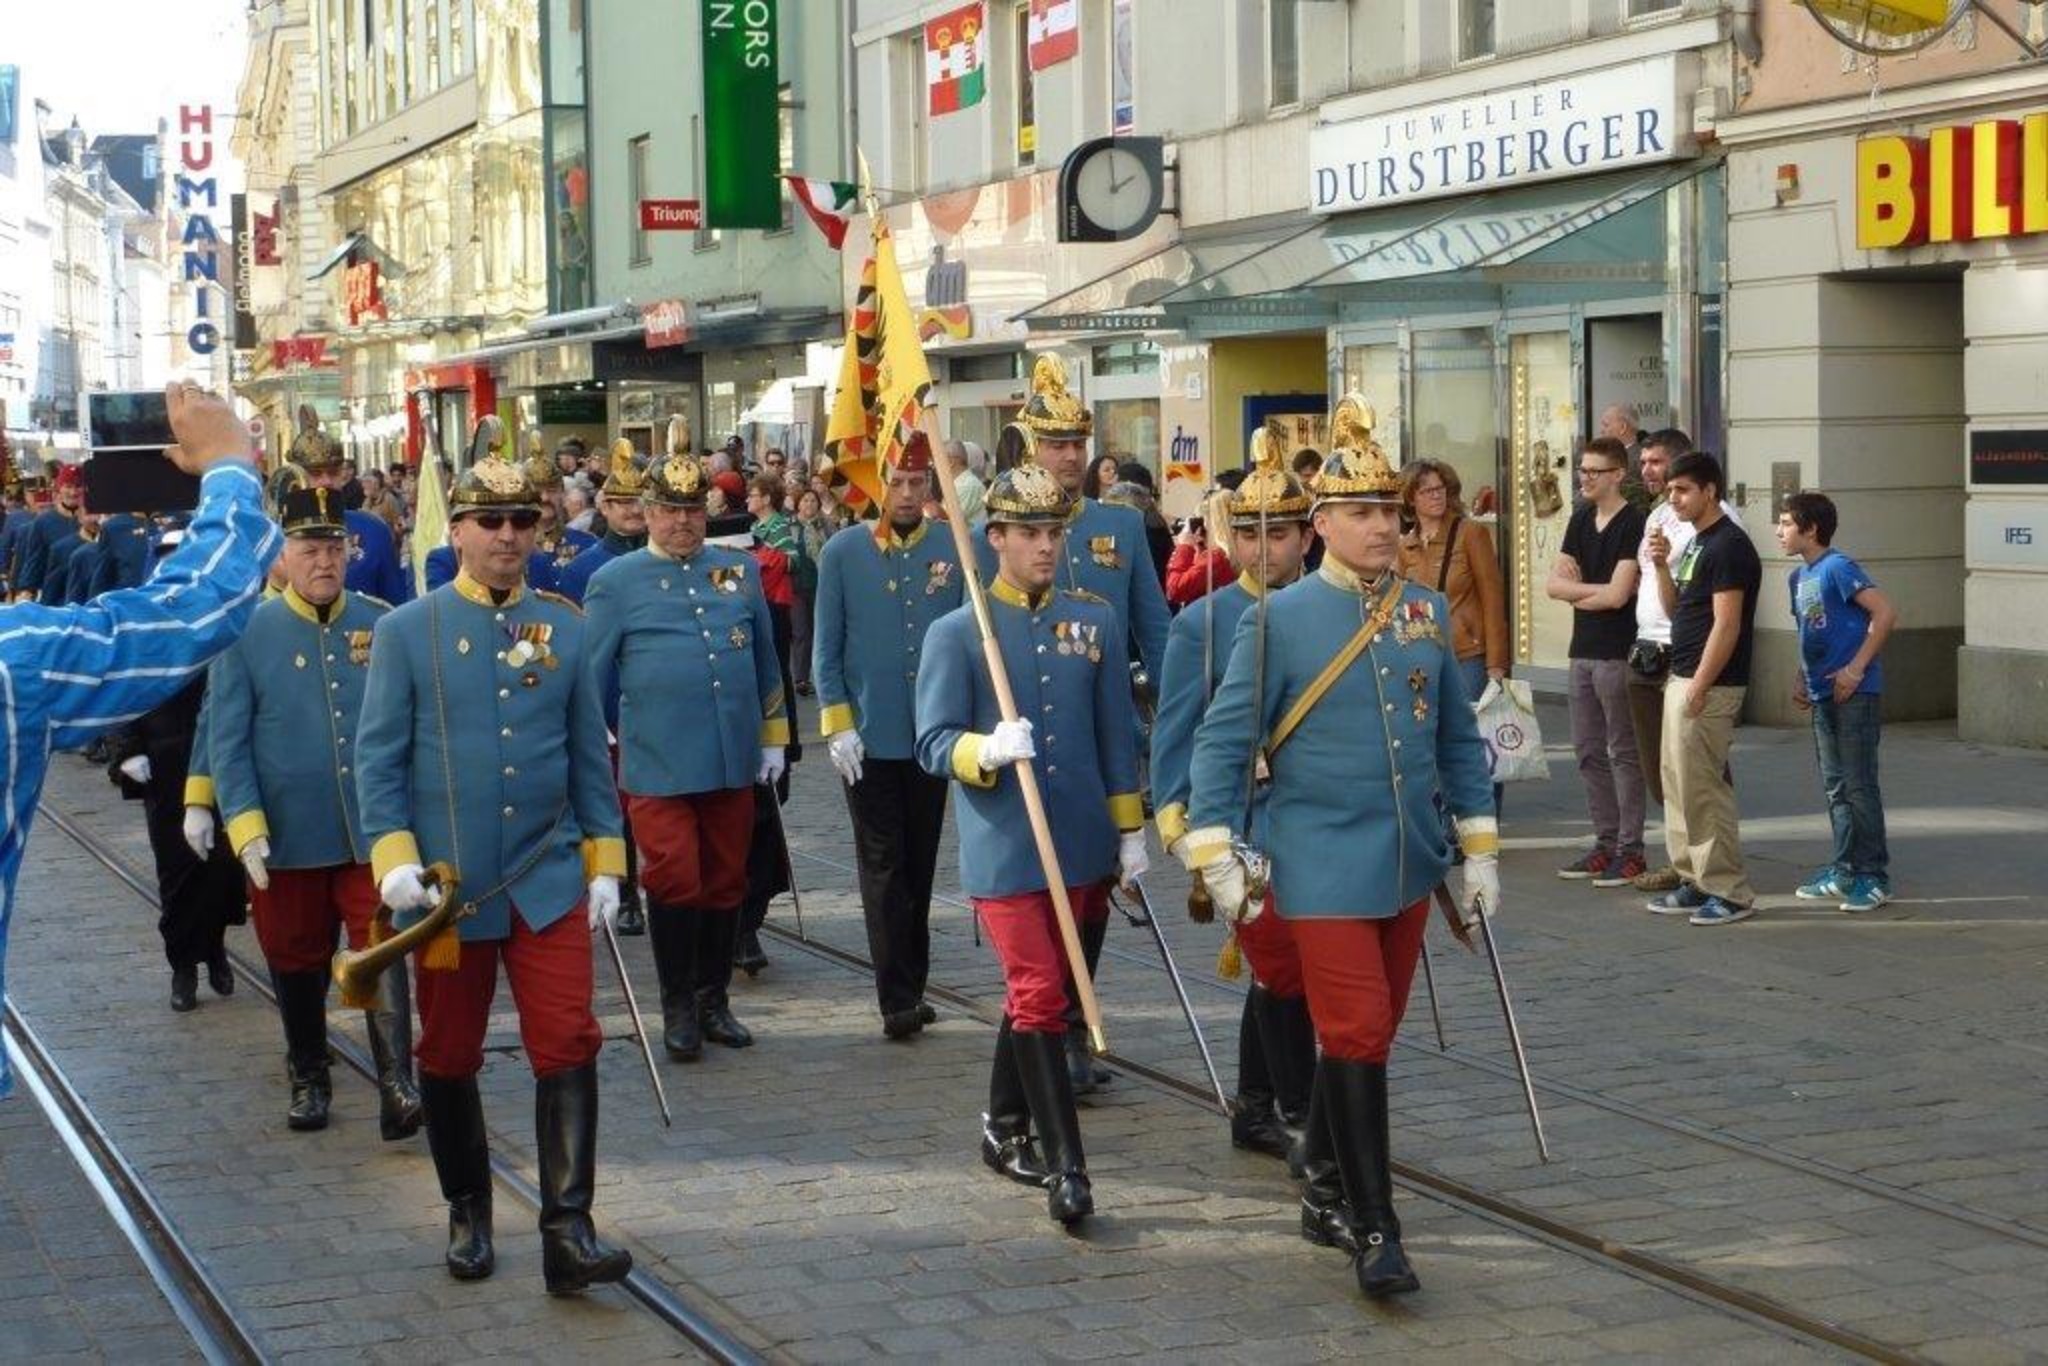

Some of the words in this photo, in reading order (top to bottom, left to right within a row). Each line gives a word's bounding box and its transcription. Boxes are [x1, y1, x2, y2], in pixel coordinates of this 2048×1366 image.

[744, 1, 770, 69] ORS
[1384, 89, 1574, 149] JUWELIER
[1317, 108, 1664, 208] DURSTBERGER
[1172, 425, 1198, 462] dm
